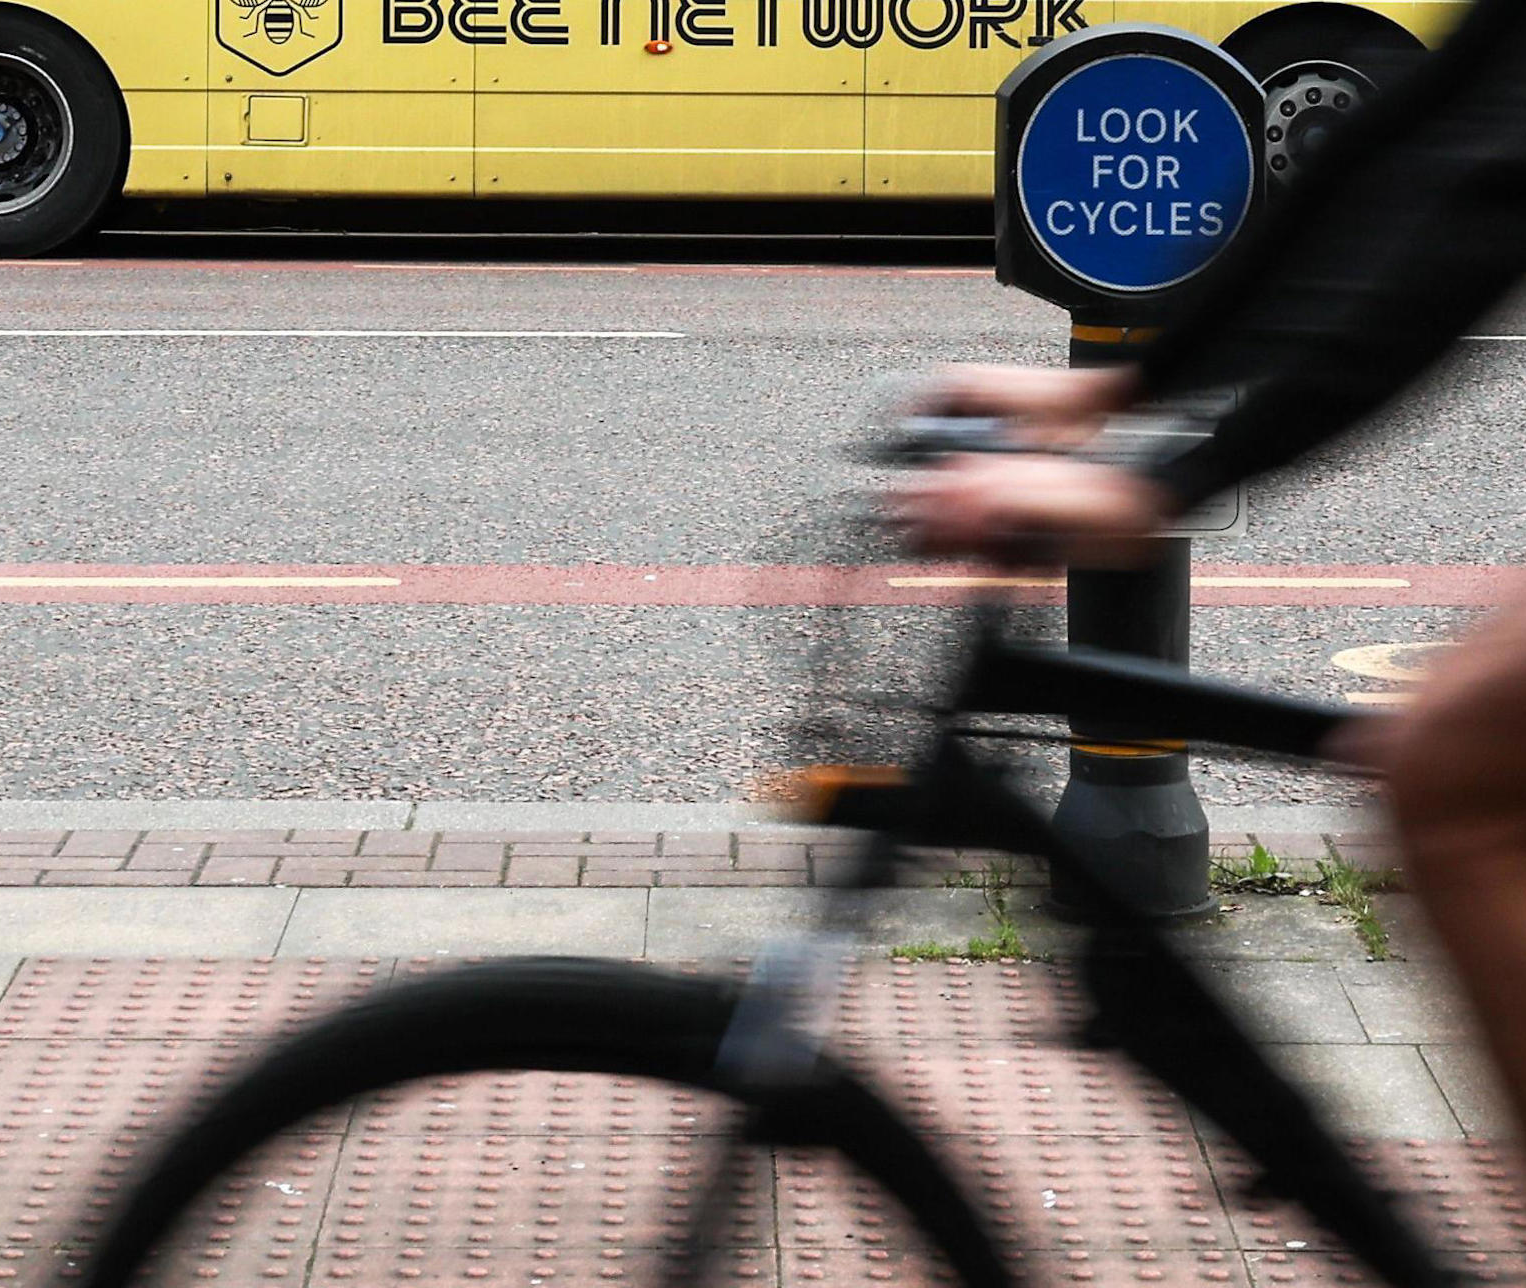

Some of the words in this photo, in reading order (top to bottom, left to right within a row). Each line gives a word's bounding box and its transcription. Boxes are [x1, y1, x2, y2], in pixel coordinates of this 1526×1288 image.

[1076, 108, 1199, 144] LOOK
[1092, 155, 1180, 190] FOR
[1045, 200, 1224, 237] CYCLES
